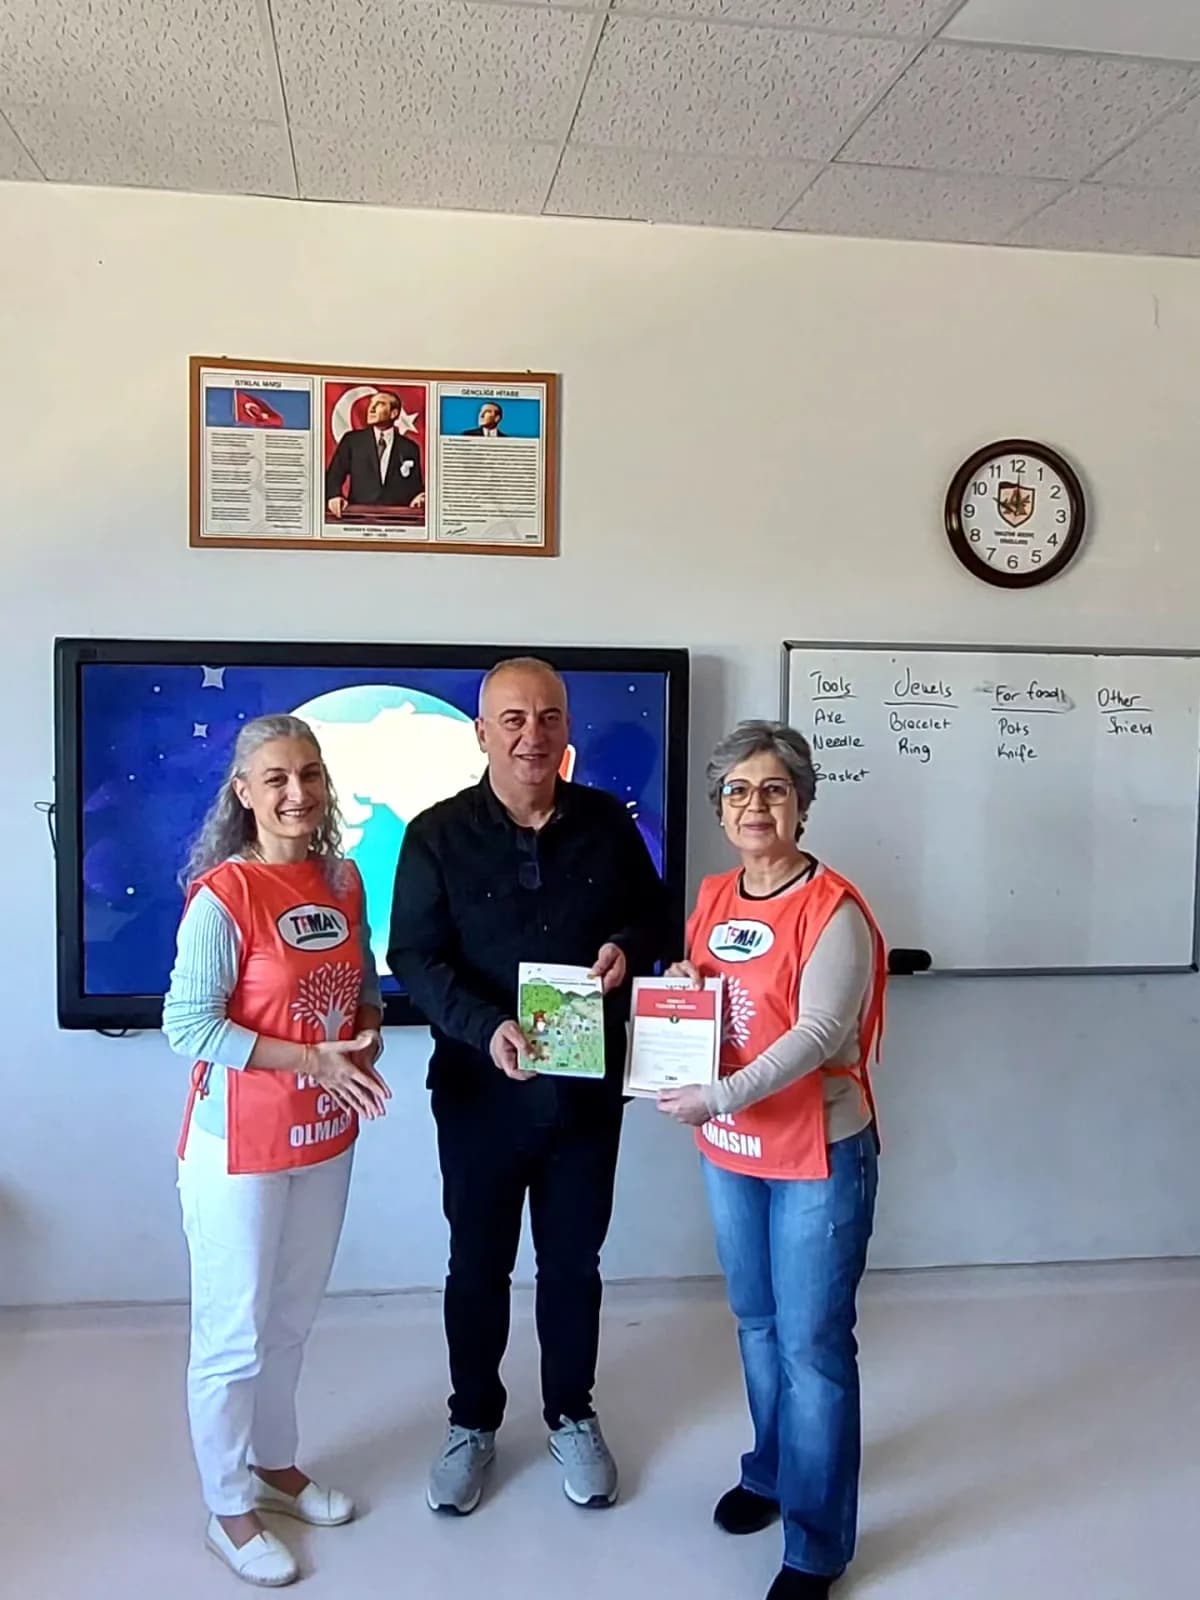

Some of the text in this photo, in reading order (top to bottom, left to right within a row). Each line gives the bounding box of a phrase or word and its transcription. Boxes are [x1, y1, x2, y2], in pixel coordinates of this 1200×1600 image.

[989, 464, 1001, 478] 11
[1010, 459, 1026, 473] 12
[1037, 467, 1043, 481] 1
[973, 481, 987, 496] 10
[1050, 485, 1061, 499] 2
[963, 504, 976, 518] 9
[1055, 509, 1066, 523] 3
[970, 528, 981, 542] 8
[1047, 532, 1058, 546] 4
[986, 547, 997, 560] 7
[1031, 550, 1042, 563] 5
[1007, 555, 1018, 569] 6
[809, 671, 852, 695] Tools
[996, 684, 1021, 701] For
[1097, 688, 1142, 707] Other
[814, 708, 846, 725] Axe
[889, 711, 952, 732] Bracelet
[999, 717, 1029, 736] Pots
[812, 733, 865, 750] Needle
[898, 737, 931, 763] Ring
[997, 743, 1038, 762] Knife
